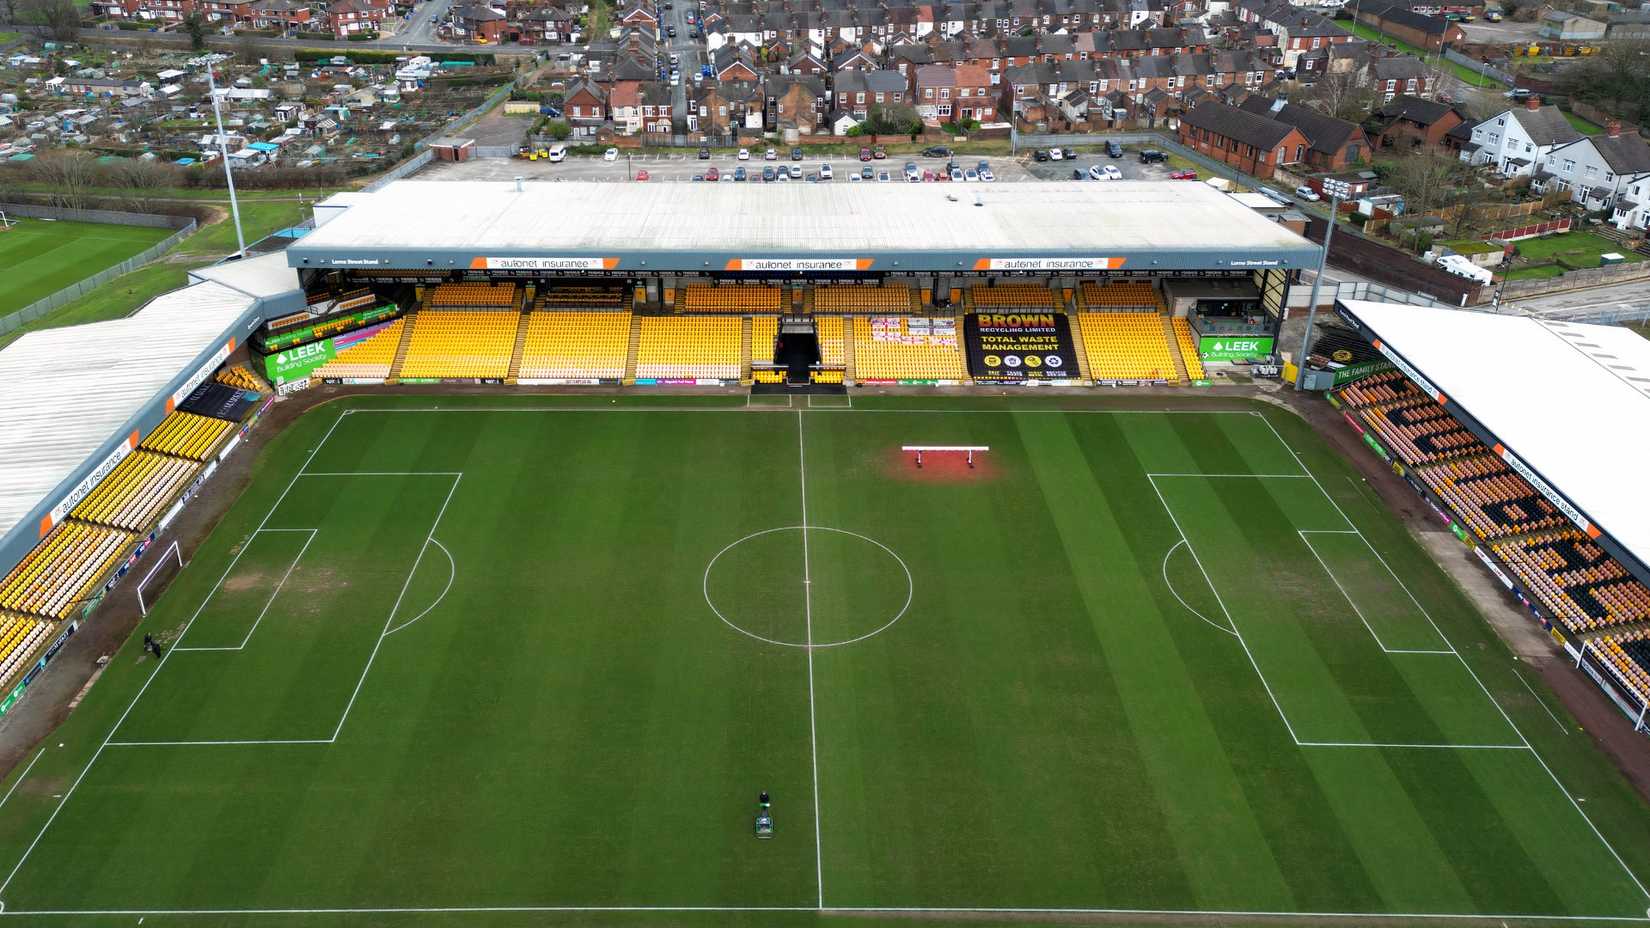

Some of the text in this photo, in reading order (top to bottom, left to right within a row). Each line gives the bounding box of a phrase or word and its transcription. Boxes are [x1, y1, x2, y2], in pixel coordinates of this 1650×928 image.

[500, 259, 589, 268] autonet insurance
[755, 260, 842, 269] autonet insurance
[1004, 259, 1094, 268] autonet insurance
[978, 313, 1055, 328] BROWN
[289, 340, 326, 361] LEEK
[1225, 341, 1259, 351] LEEK
[1338, 370, 1350, 379] THE
[1351, 364, 1375, 376] FAMILY
[62, 451, 122, 514] autonet insurance
[1510, 458, 1579, 521] autonet insurance stand
